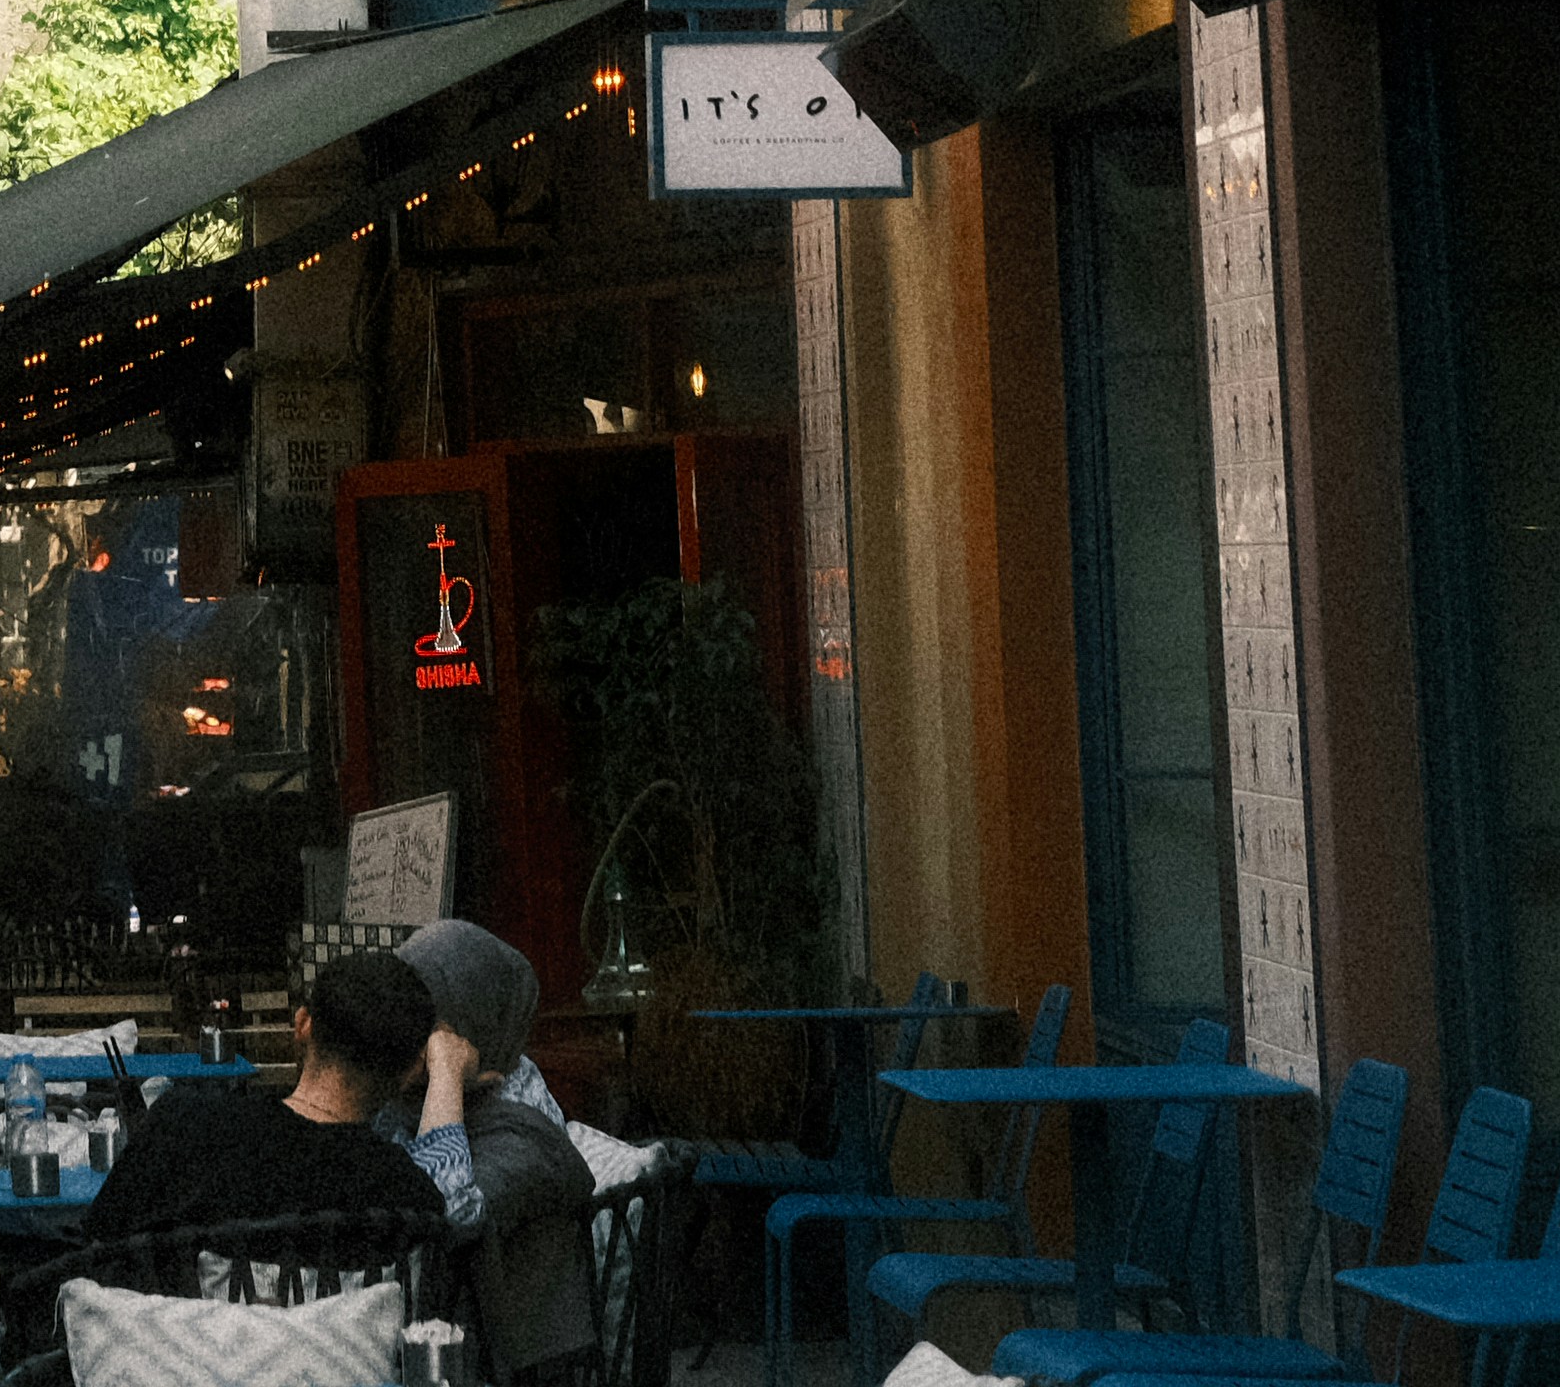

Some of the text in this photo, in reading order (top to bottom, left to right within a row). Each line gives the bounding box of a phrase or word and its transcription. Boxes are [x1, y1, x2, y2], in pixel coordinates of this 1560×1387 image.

[805, 95, 862, 119] O
[287, 440, 328, 464] BNE
[415, 662, 481, 689] SHISHA
